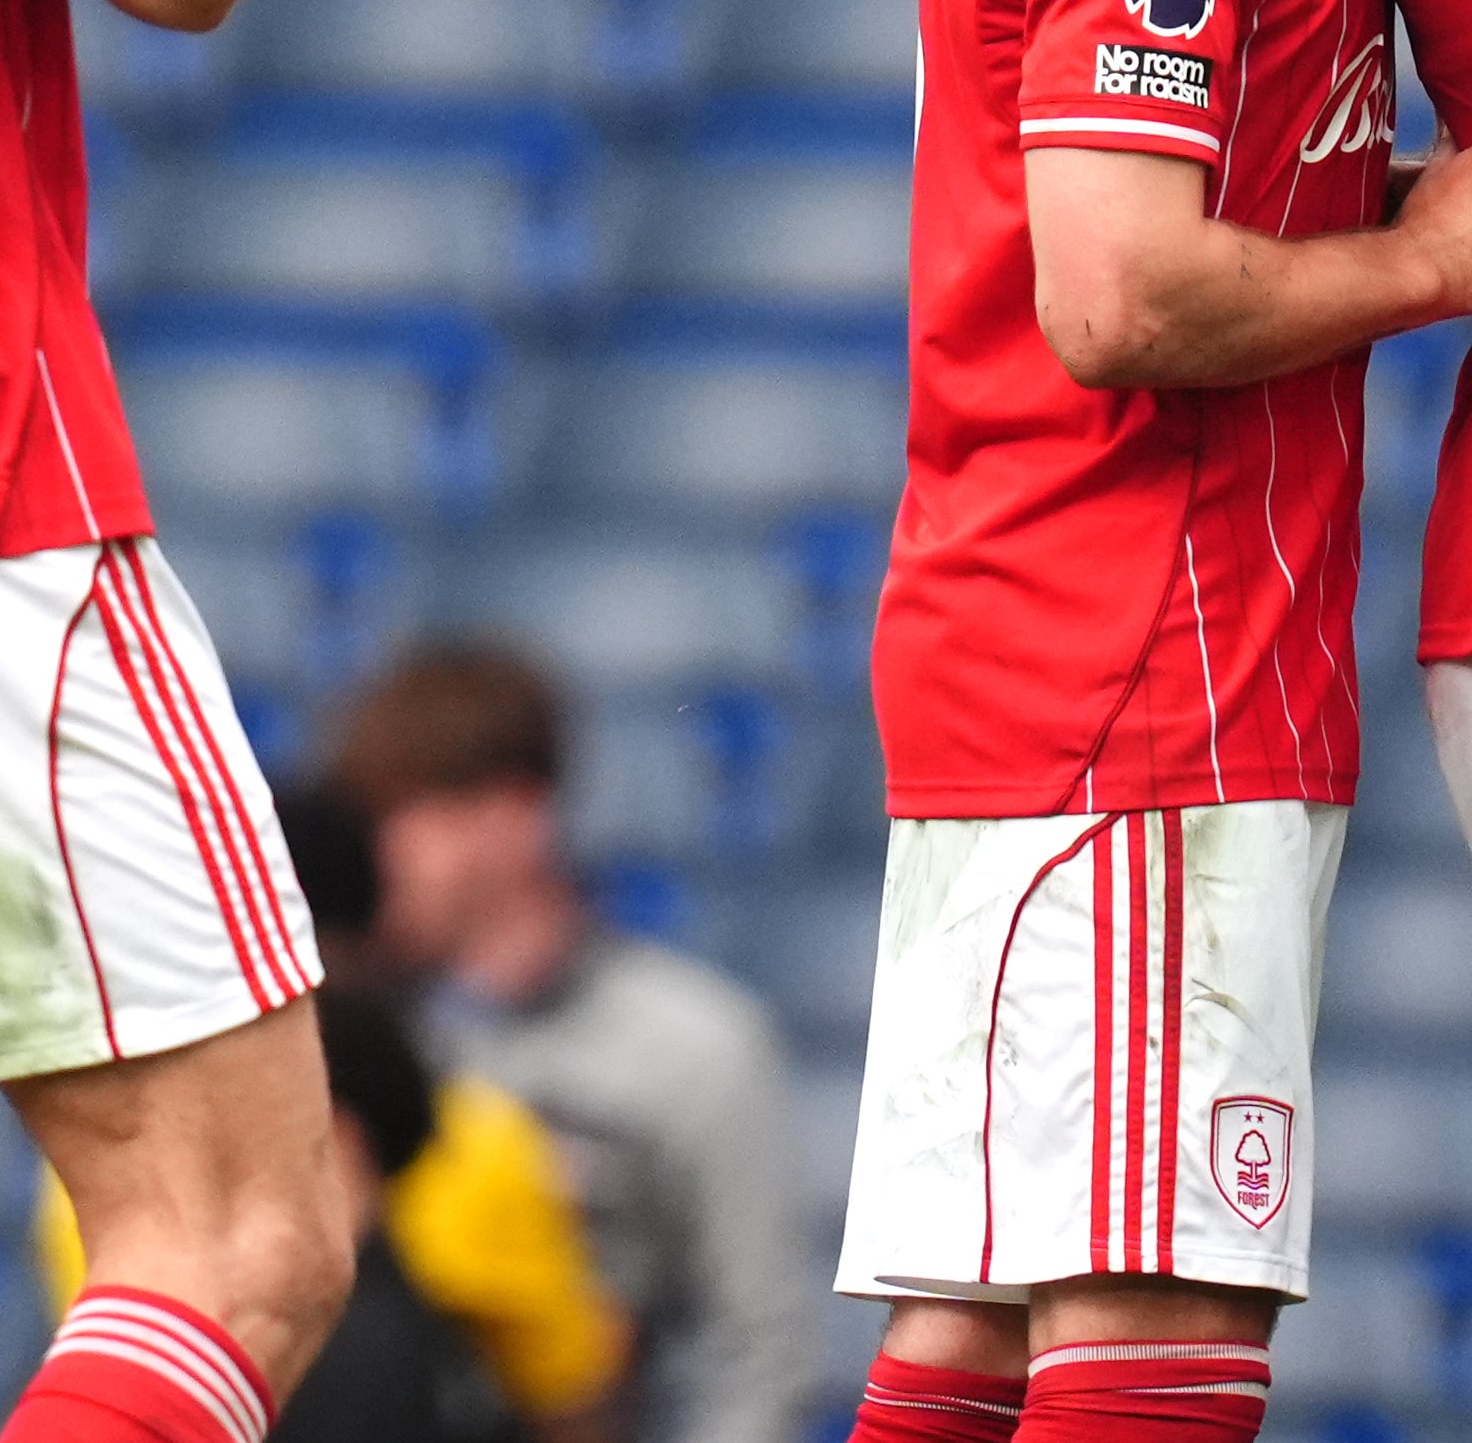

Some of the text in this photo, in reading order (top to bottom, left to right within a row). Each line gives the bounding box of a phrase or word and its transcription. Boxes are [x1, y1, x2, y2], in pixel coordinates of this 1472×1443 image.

[1096, 44, 1205, 84] No room
[1094, 67, 1209, 109] for racism
